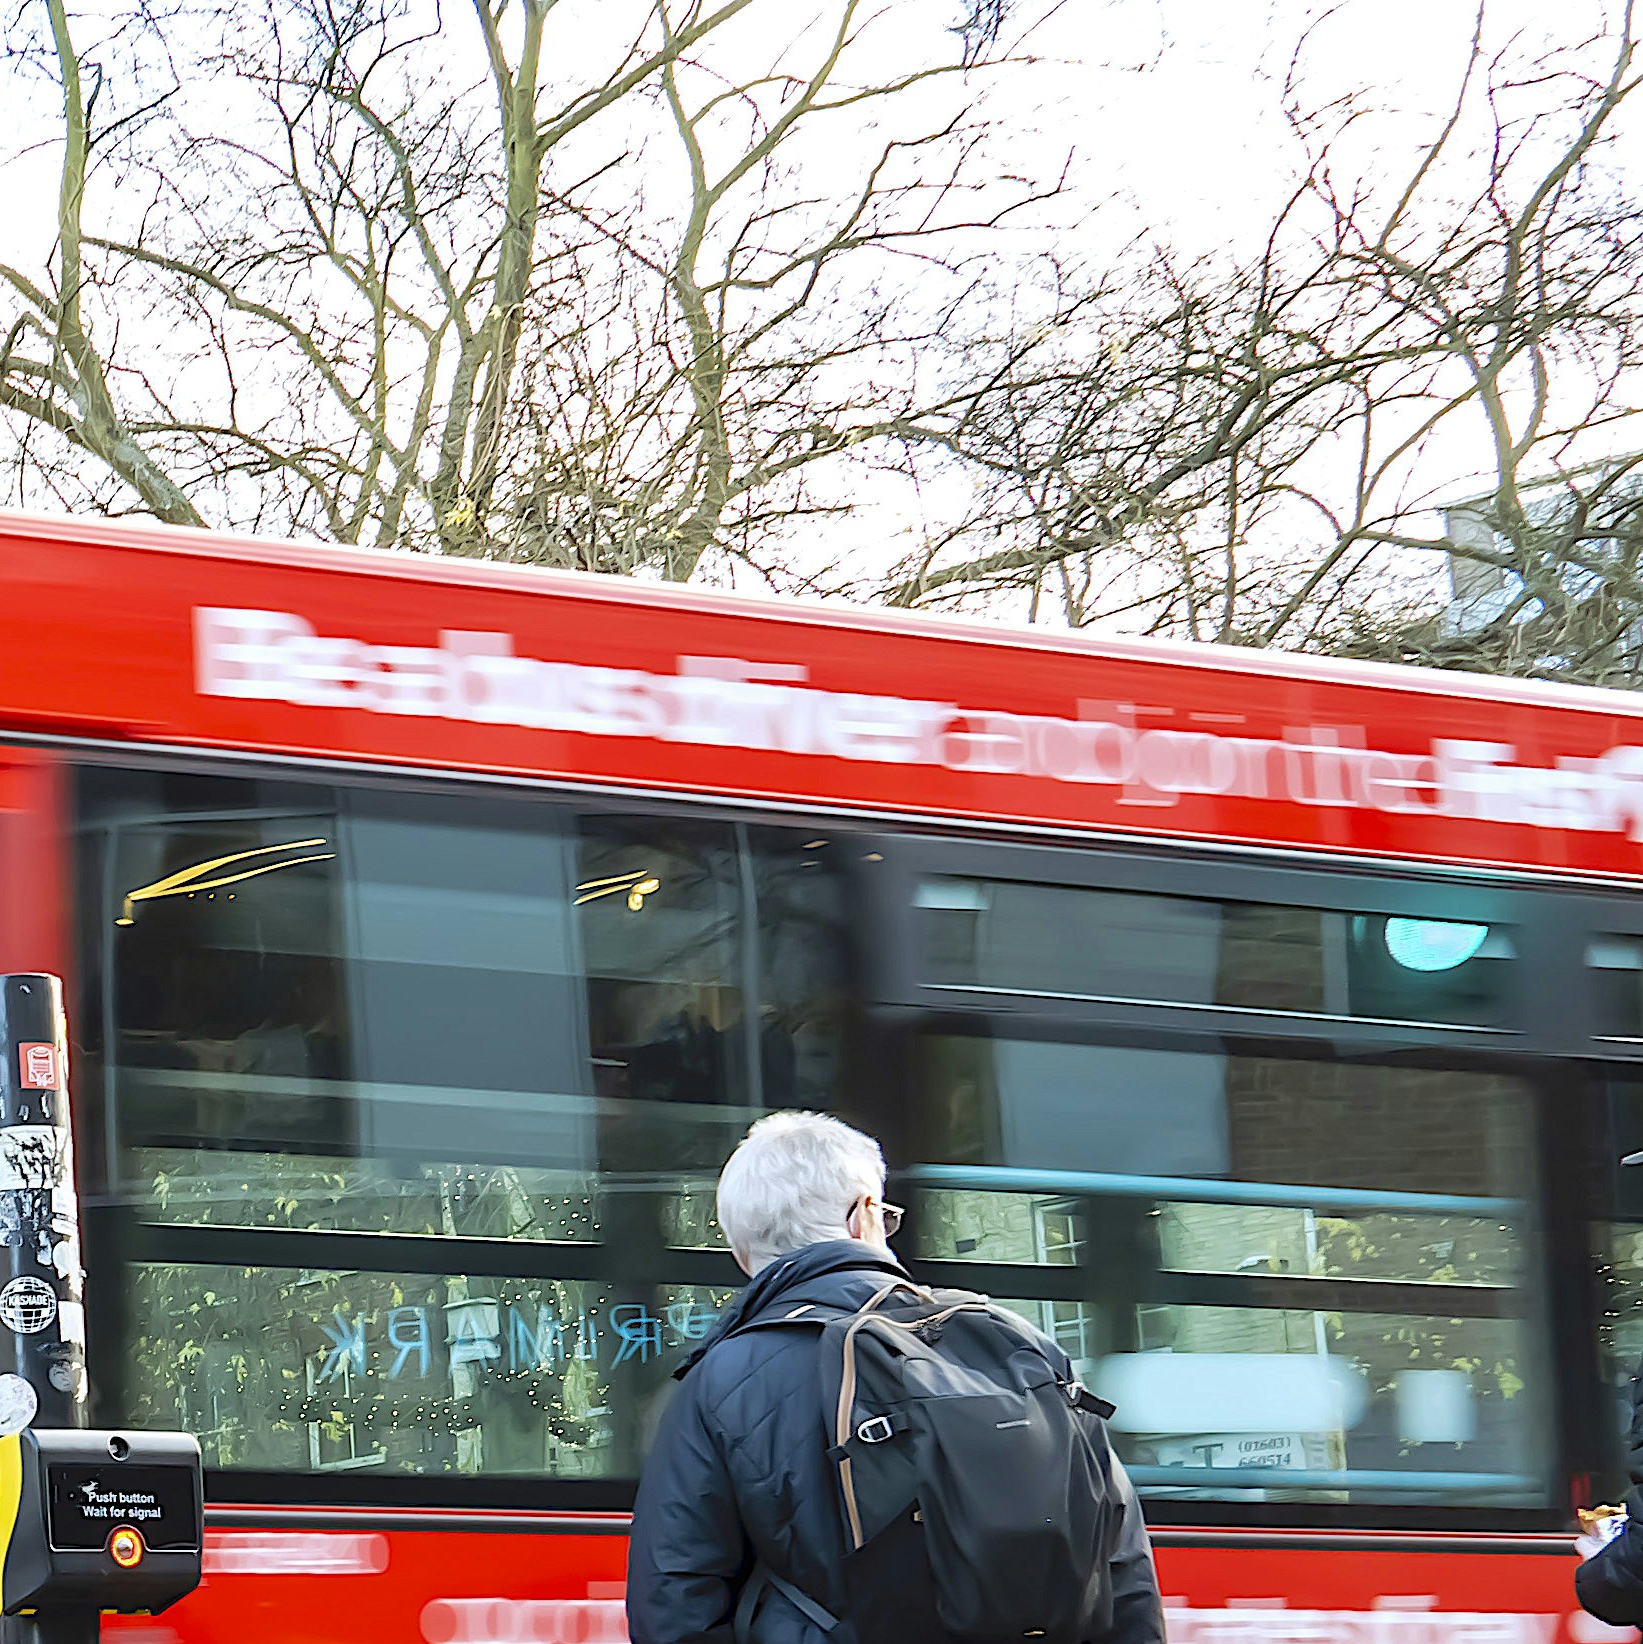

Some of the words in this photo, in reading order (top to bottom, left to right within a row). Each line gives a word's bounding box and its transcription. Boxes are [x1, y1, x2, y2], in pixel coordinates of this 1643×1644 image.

[88, 1491, 117, 1503] Push
[119, 1492, 155, 1504] button
[82, 1505, 108, 1518] Wait
[109, 1505, 127, 1518] for
[128, 1506, 162, 1521] signal
